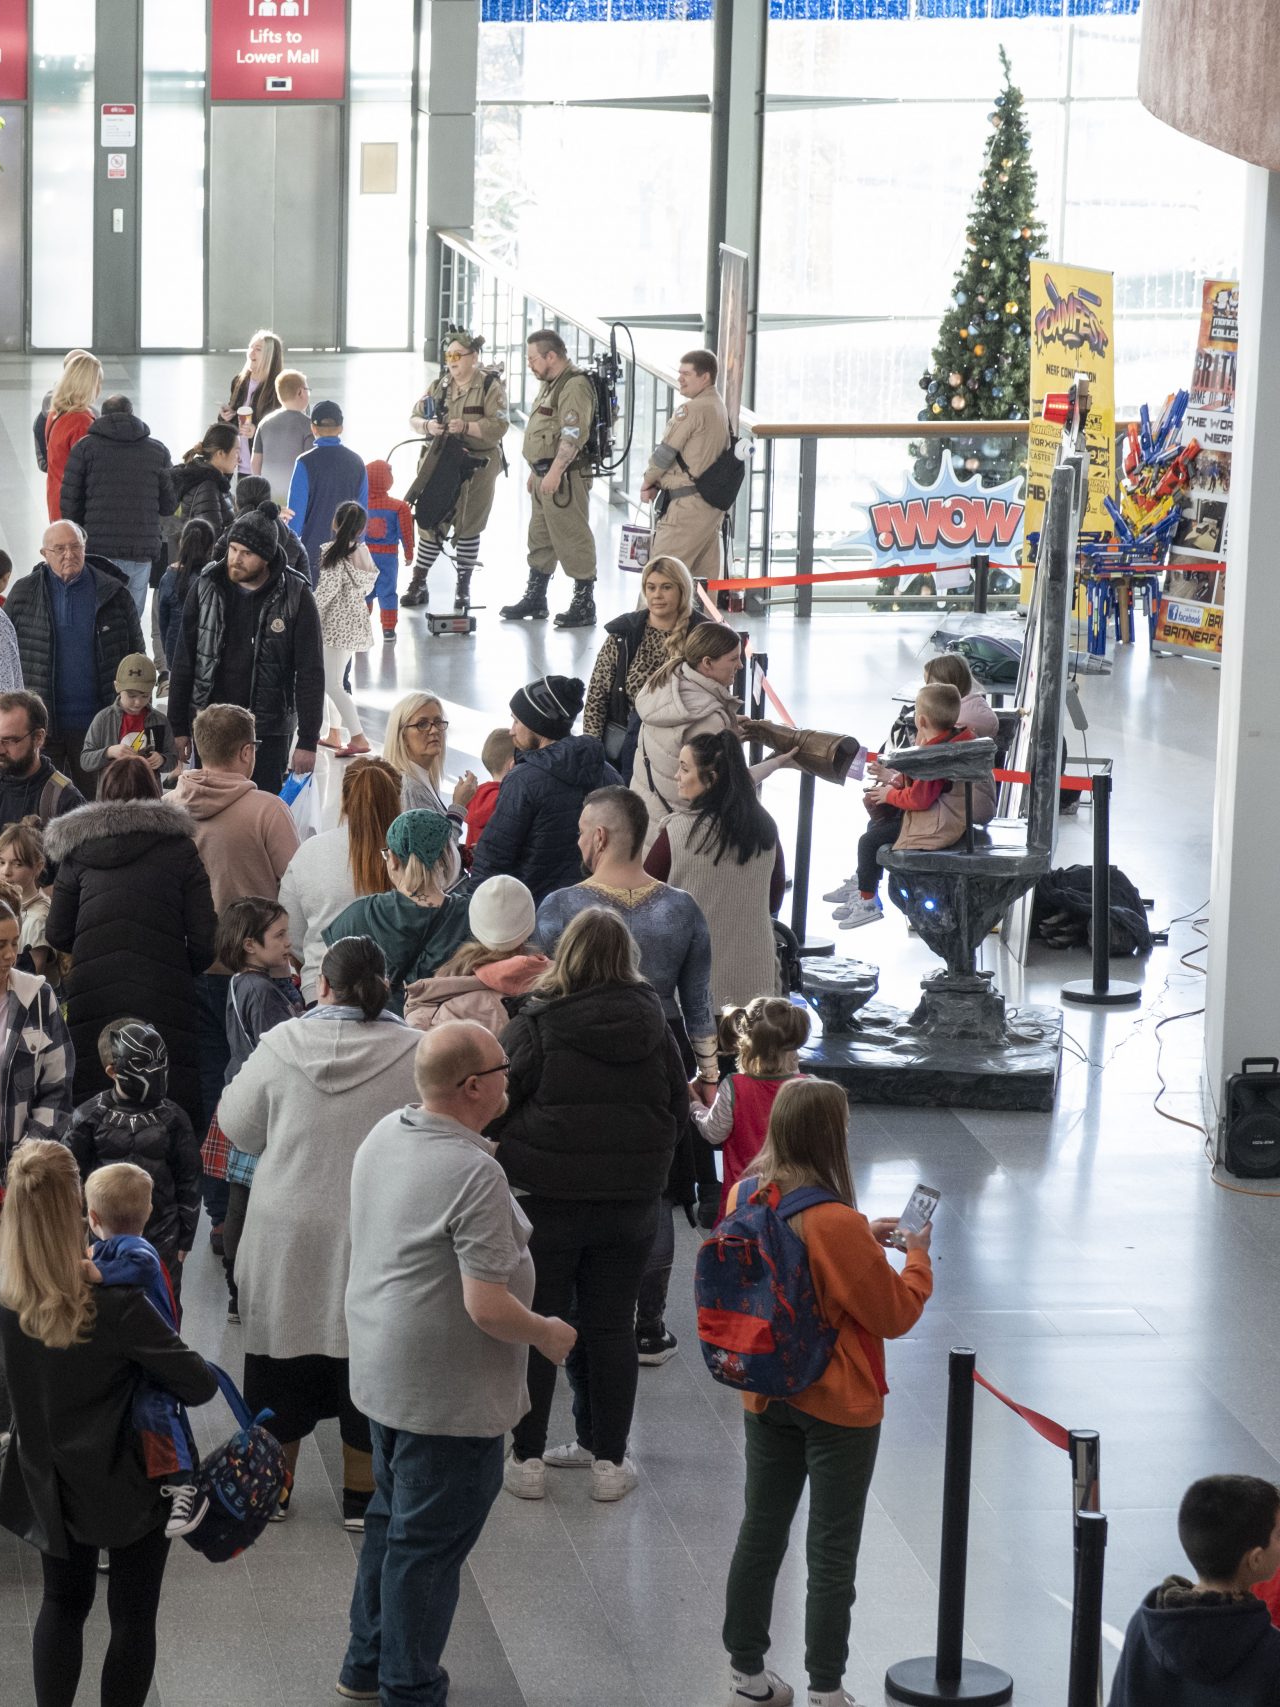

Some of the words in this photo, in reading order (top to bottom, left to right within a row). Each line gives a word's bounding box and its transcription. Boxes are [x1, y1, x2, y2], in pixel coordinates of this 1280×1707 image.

[250, 28, 282, 44] Lifts
[285, 31, 302, 44] to
[236, 49, 283, 64] Lower
[287, 49, 319, 64] Mall
[1046, 363, 1060, 377] NERF
[1187, 416, 1207, 428] THE
[1210, 418, 1233, 431] WOR
[1178, 612, 1201, 625] facebook
[1163, 624, 1216, 644] BRITNERF
